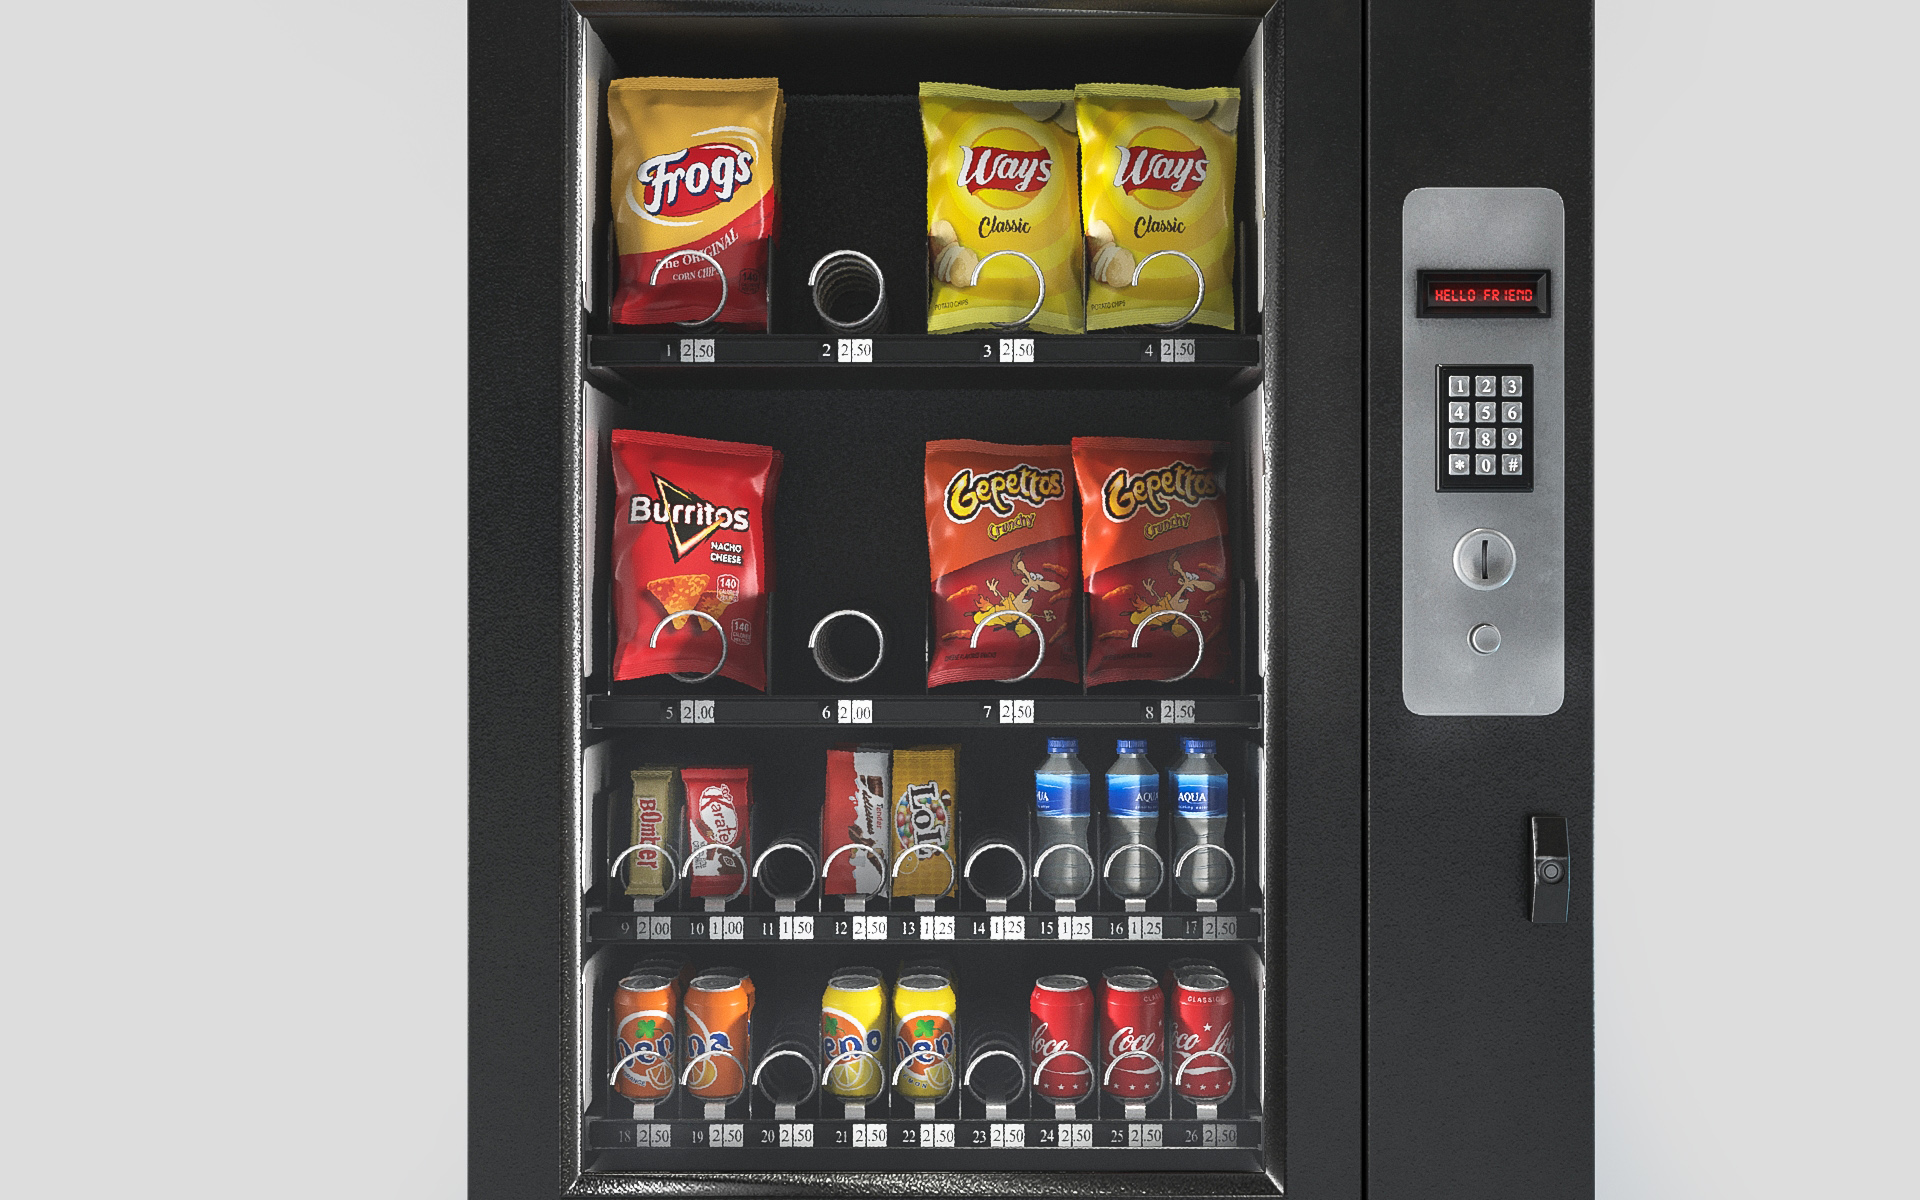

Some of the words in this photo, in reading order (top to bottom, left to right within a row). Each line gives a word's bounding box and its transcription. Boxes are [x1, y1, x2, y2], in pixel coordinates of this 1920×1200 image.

[956, 145, 1054, 192] Ways
[1113, 145, 1210, 192] Ways
[637, 148, 753, 216] Frogs
[978, 216, 1031, 238] Classic
[1133, 215, 1186, 238] Classic
[672, 270, 696, 281] CORN
[1434, 289, 1476, 302] HELLO
[1482, 289, 1533, 302] FRIEND
[666, 344, 671, 357] 1
[822, 343, 831, 357] 2
[983, 344, 992, 358] 3
[1144, 344, 1154, 357] 4
[1456, 379, 1464, 392] 1
[1481, 379, 1491, 393] 2
[1507, 379, 1517, 394] 3
[1454, 405, 1464, 420] 4
[1481, 405, 1491, 420] 5
[1507, 405, 1517, 420] 6
[1455, 431, 1464, 445] 7
[1481, 431, 1490, 446] 8
[1507, 431, 1517, 446] 9
[1481, 458, 1490, 472] 0
[947, 466, 1063, 520] Gepettos
[1105, 463, 1218, 519] Gepettos
[629, 496, 750, 531] Burritos
[989, 513, 1035, 540] Crunchy
[1145, 513, 1190, 539] Crunchy
[710, 541, 742, 553] NACHO
[710, 552, 742, 564] CHEESE
[720, 577, 737, 588] 140
[666, 706, 674, 719] 5
[822, 705, 831, 719] 6
[983, 705, 992, 719] 7
[1145, 706, 1154, 719] 8
[1178, 791, 1207, 803] AQUA
[700, 794, 737, 842] Karate
[621, 922, 630, 934] 9
[690, 922, 704, 935] 10
[763, 922, 774, 935] 11
[835, 922, 848, 935] 12
[902, 922, 916, 935] 13
[973, 922, 986, 935] 14
[1041, 922, 1054, 934] 15
[1110, 922, 1124, 935] 16
[1186, 921, 1198, 934] 17
[1187, 995, 1220, 1003] CLASSIC
[1108, 1026, 1156, 1059] Coco
[900, 1069, 927, 1089] EMON
[619, 1131, 631, 1143] 18
[692, 1131, 704, 1143] 19
[761, 1130, 775, 1143] 20
[835, 1131, 847, 1143] 21
[902, 1130, 916, 1142] 22
[973, 1130, 986, 1143] 23
[1040, 1130, 1054, 1143] 24
[1111, 1130, 1124, 1143] 25
[1185, 1130, 1198, 1143] 26
